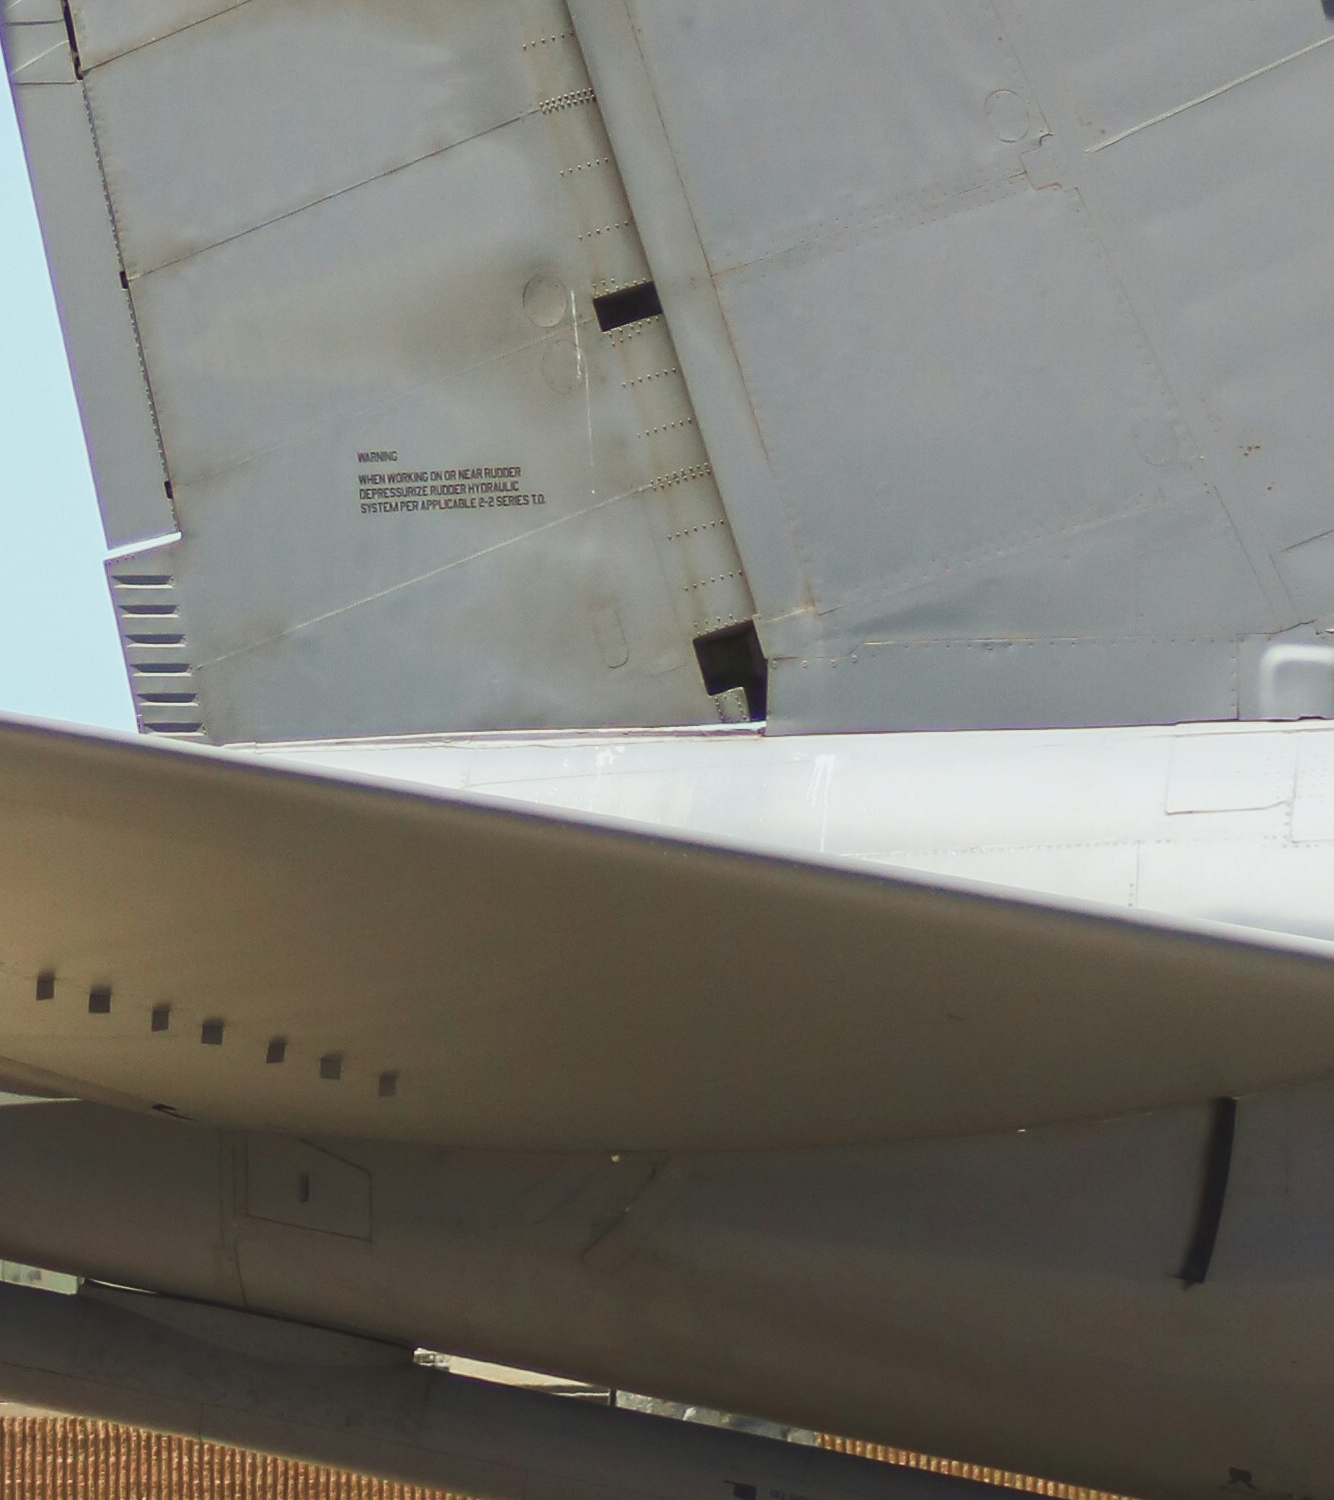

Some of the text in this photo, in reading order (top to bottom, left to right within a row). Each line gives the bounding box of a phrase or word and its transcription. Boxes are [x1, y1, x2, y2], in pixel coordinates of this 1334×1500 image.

[357, 451, 398, 463] WARNING
[358, 467, 521, 485] WHEN WORKING ON OR NEAR RUDDER
[359, 481, 519, 500] DEPRESSURIZE RUDDER HYDRAULIC
[361, 502, 399, 514] SYSTEM
[400, 500, 419, 511] PER
[421, 497, 476, 511] APPLICABLE
[478, 496, 495, 508] 2-2
[496, 495, 529, 507] SERIES
